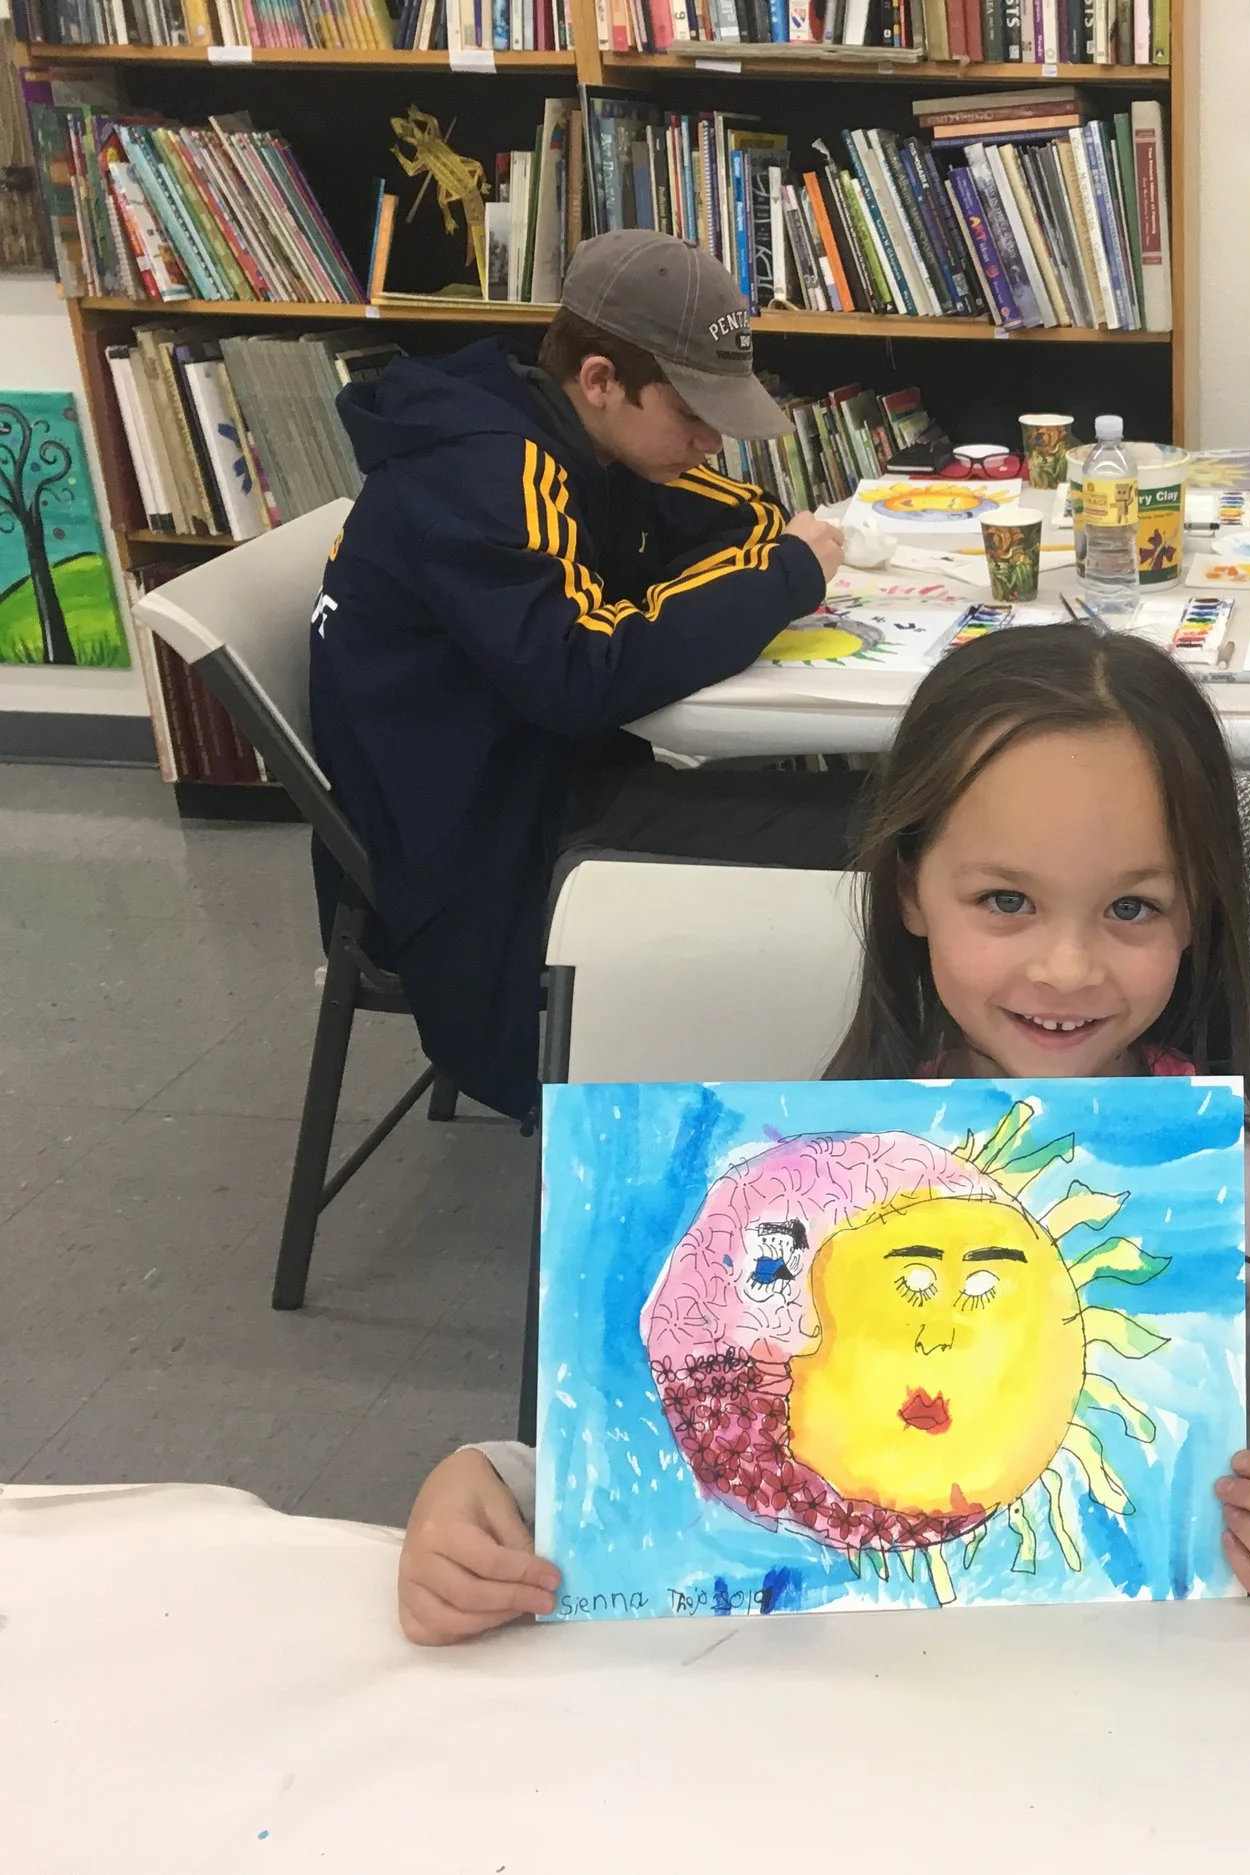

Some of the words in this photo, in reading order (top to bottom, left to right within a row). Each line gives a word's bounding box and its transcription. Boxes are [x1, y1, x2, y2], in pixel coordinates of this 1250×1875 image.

[908, 141, 929, 189] DISPOSABLE
[967, 213, 987, 243] ART
[1138, 495, 1153, 506] ry
[1155, 489, 1180, 503] Clay
[560, 1590, 650, 1617] Sienna
